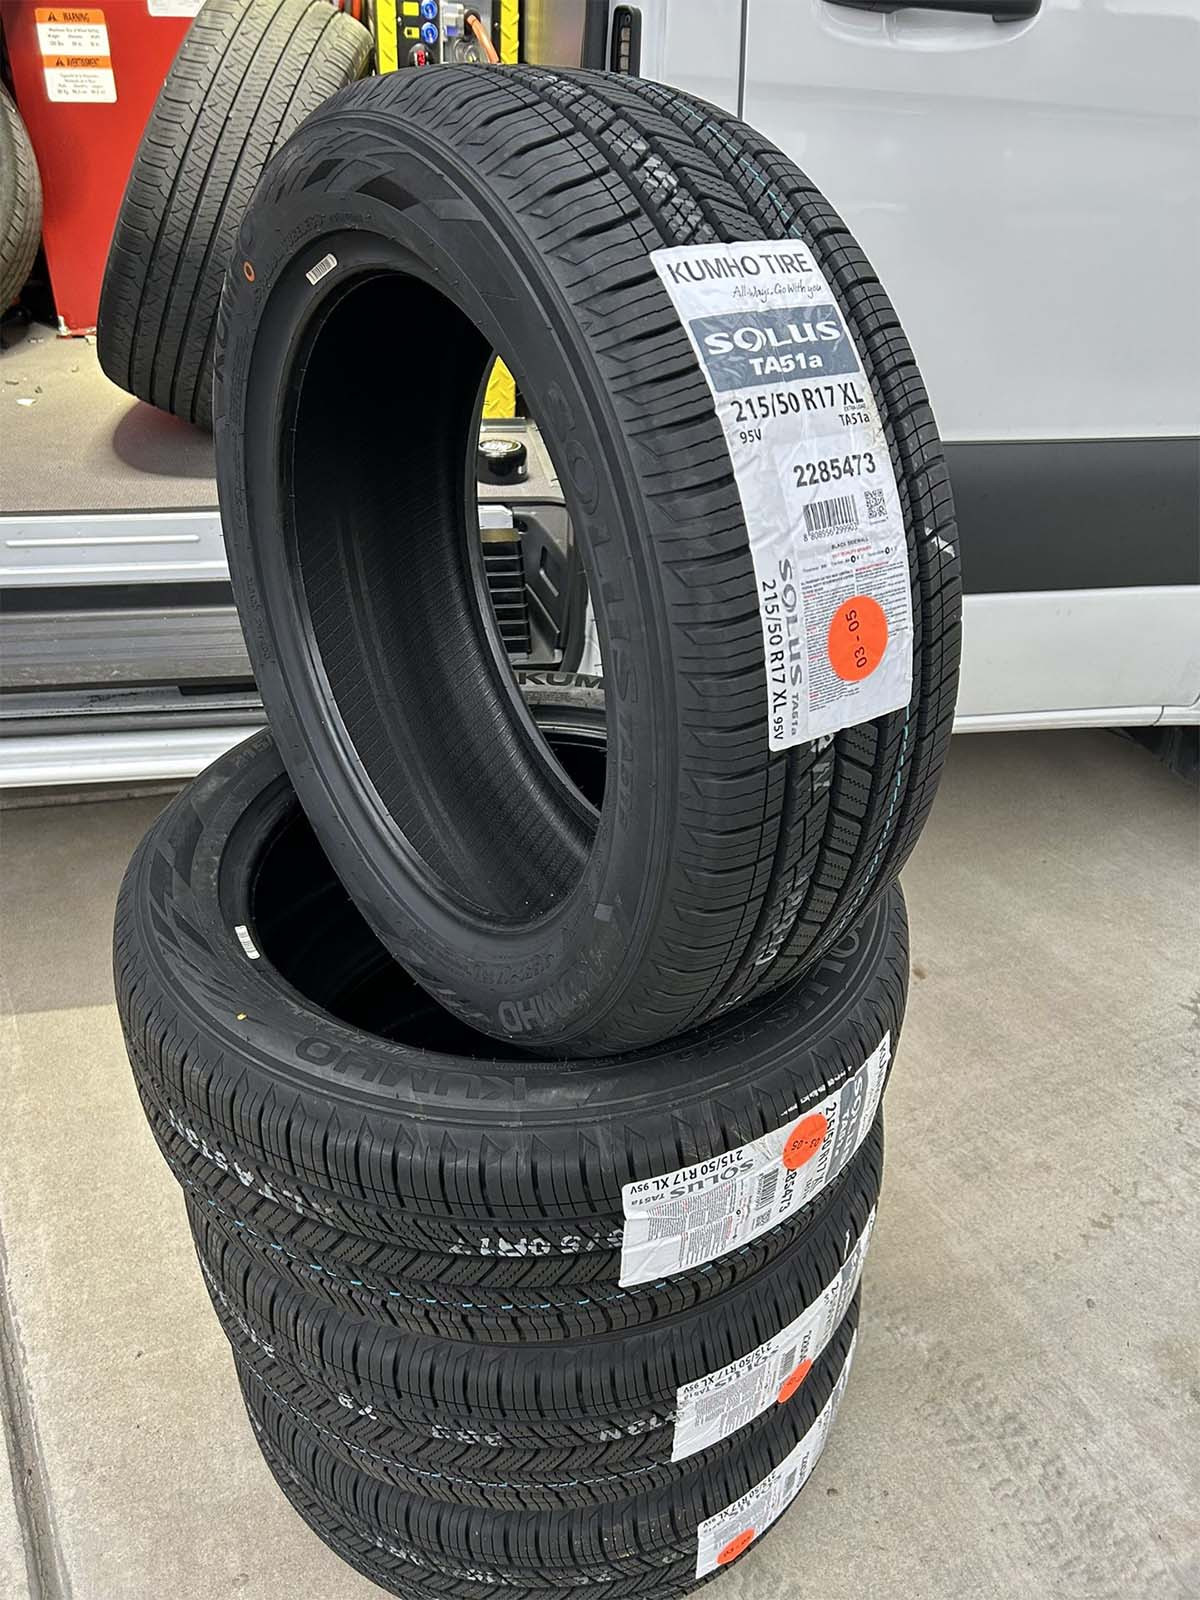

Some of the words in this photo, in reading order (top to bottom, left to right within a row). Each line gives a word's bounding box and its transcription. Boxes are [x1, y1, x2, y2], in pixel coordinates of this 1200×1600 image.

[667, 255, 761, 284] KUMHO
[760, 253, 813, 275] TIRE
[774, 283, 788, 296] Go
[704, 321, 842, 356] SOLUS
[749, 352, 823, 376] TA51a
[730, 391, 801, 423] 215/50
[801, 385, 835, 411] R17
[838, 382, 864, 406] XL
[838, 412, 871, 427] TA51a
[739, 428, 762, 445] 95V
[793, 452, 876, 488] 2285473
[762, 579, 784, 646] 215/50
[778, 558, 803, 687] SOLUS
[845, 609, 860, 632] 05
[770, 651, 786, 684] R17
[854, 646, 868, 669] 03
[772, 688, 788, 713] XL
[773, 716, 785, 740] 95V
[700, 1149, 743, 1176] 215/50
[652, 1176, 670, 1190] XL
[670, 1158, 754, 1199] SOLUS
[673, 1168, 698, 1183] R17
[630, 1182, 650, 1195] 95V
[701, 1376, 715, 1387] XL
